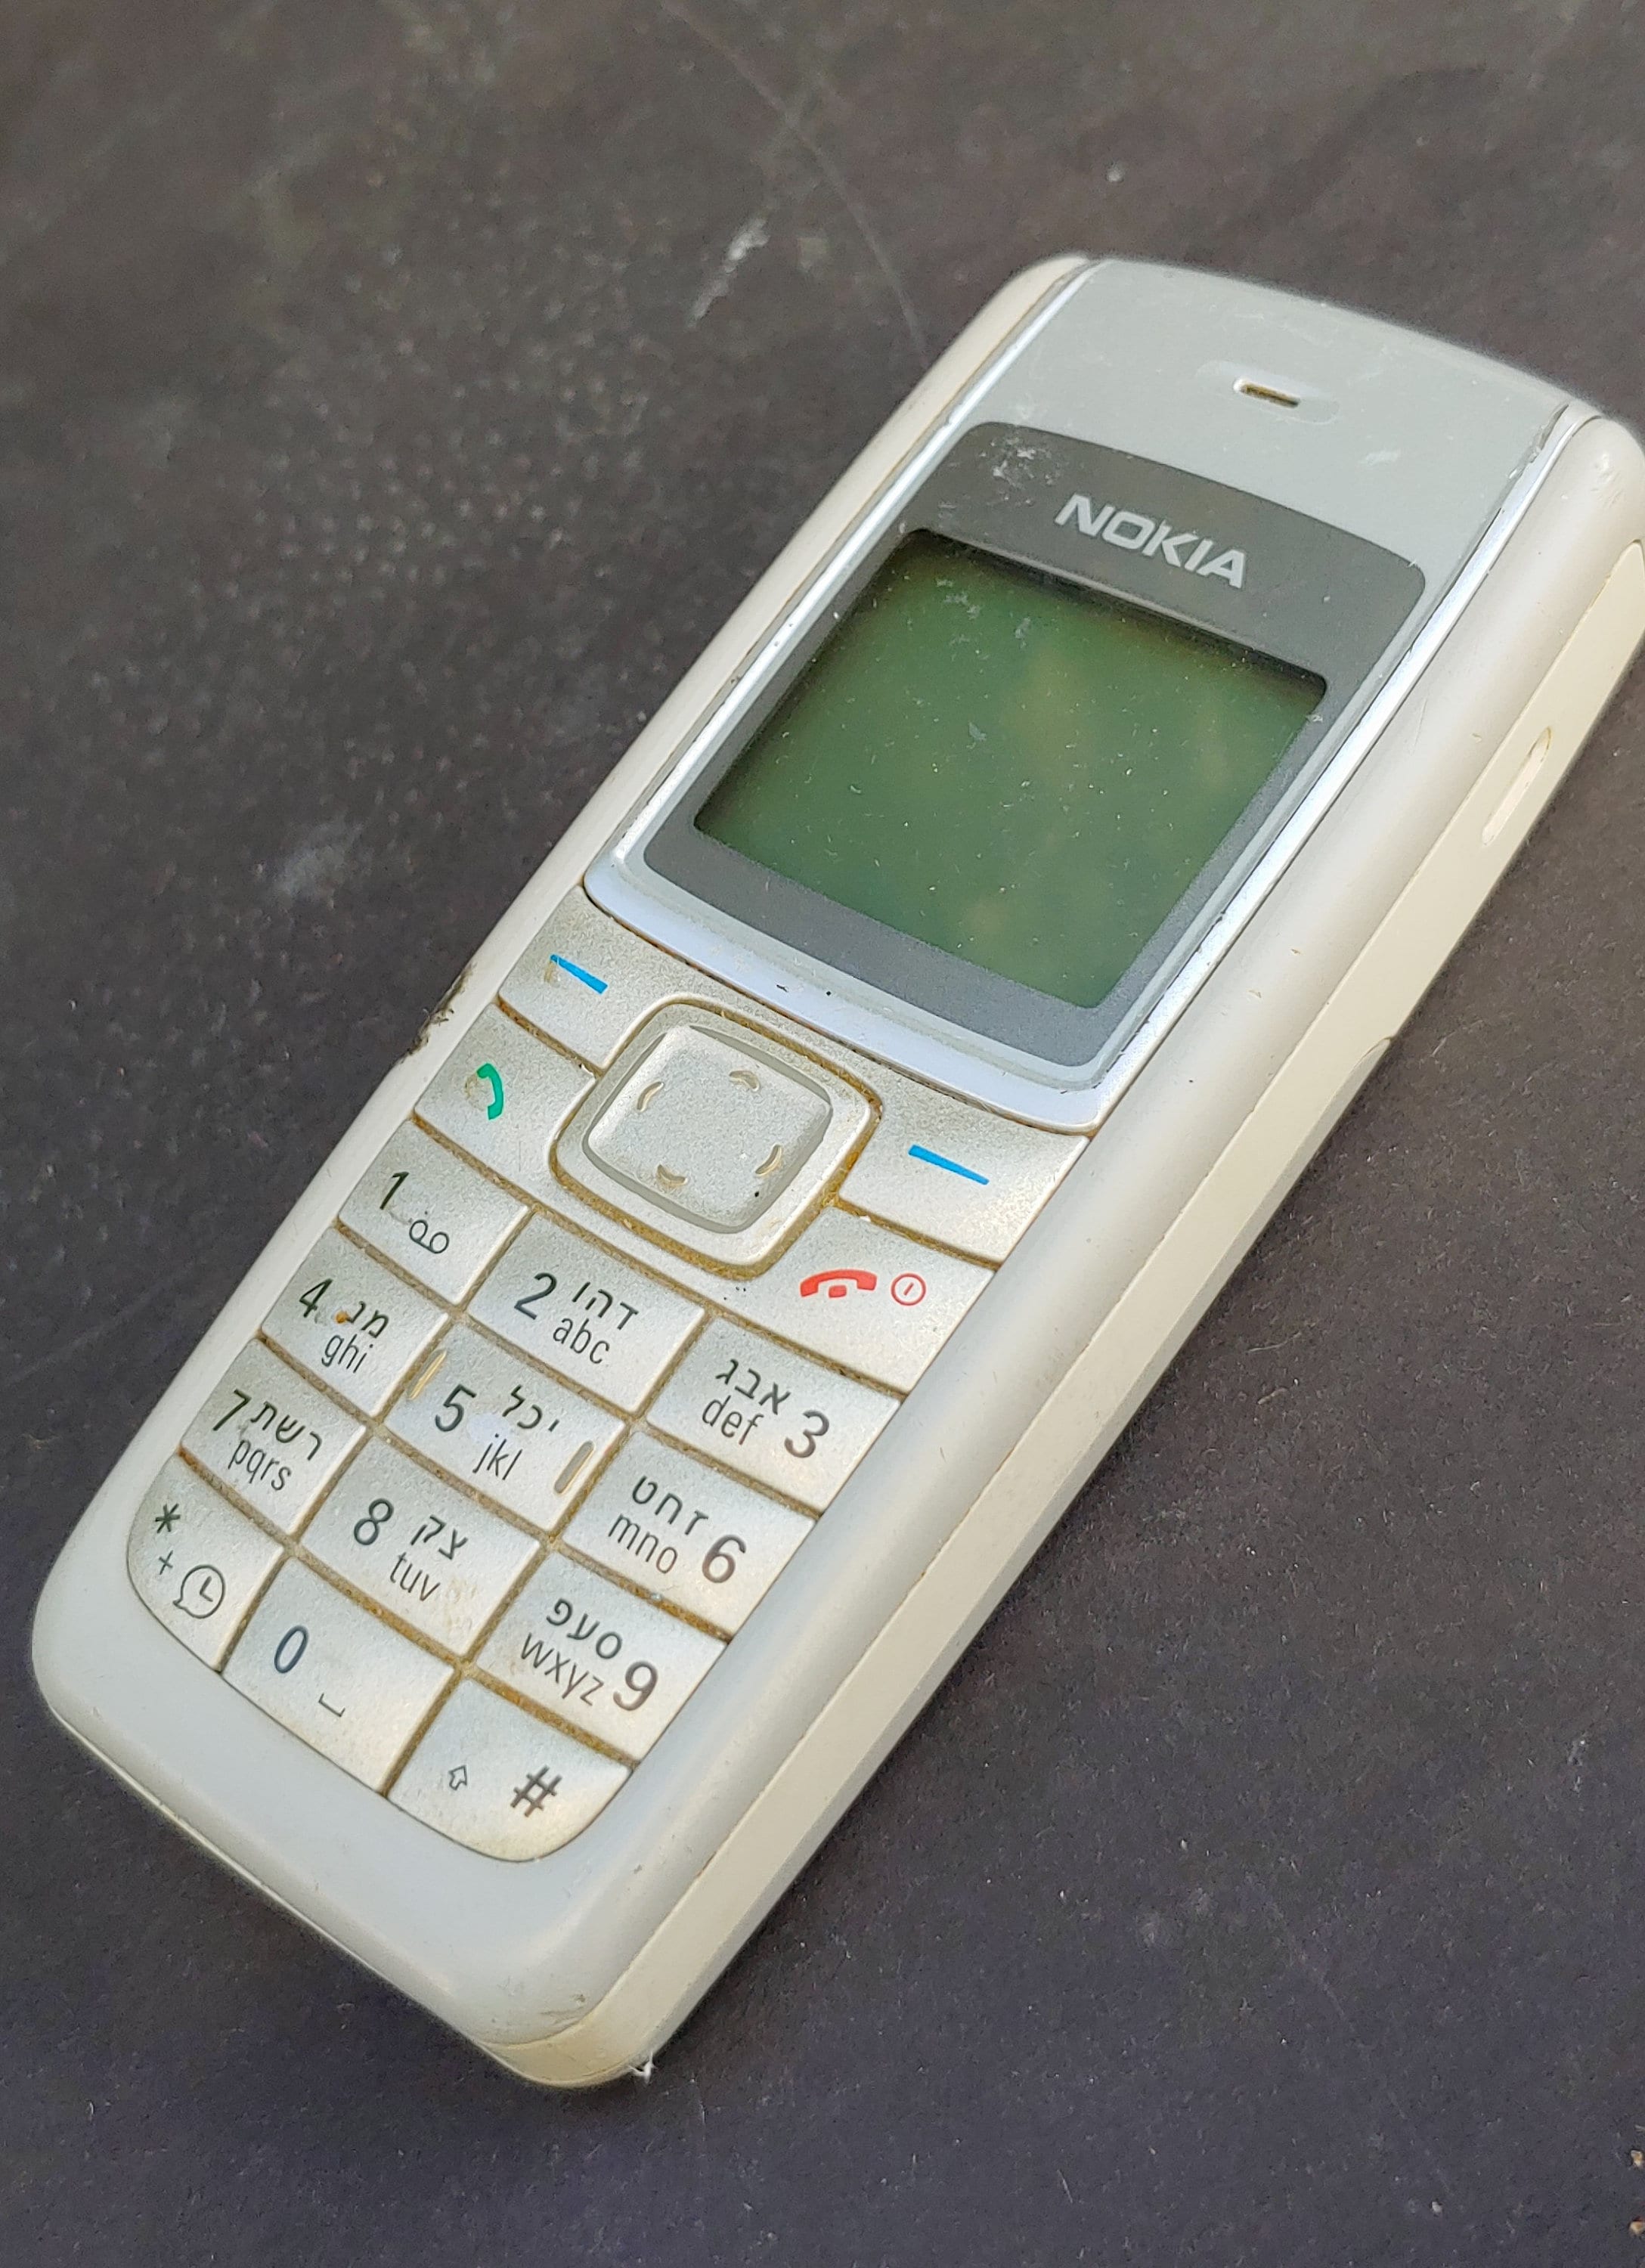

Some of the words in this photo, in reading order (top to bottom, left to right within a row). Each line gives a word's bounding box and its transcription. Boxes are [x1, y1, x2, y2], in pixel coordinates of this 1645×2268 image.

[1055, 493, 1247, 589] NOKIA
[379, 1171, 409, 1210] 1
[299, 1278, 333, 1318] 4
[514, 1272, 557, 1319] 2
[572, 1281, 639, 1331] דהו
[321, 1333, 374, 1374] ghi
[553, 1316, 611, 1365] abc
[212, 1389, 251, 1432] 7
[434, 1383, 477, 1432] 5
[501, 1385, 562, 1433] יכל
[714, 1359, 791, 1415] אבג
[250, 1401, 323, 1461] רשת
[702, 1395, 761, 1445] def
[783, 1410, 830, 1459] 3
[228, 1439, 292, 1491] pqrs
[472, 1433, 523, 1482] jkl
[353, 1498, 394, 1546] 8
[631, 1474, 708, 1538] זחט
[410, 1514, 469, 1560] צק
[608, 1513, 679, 1575] mno
[701, 1533, 747, 1583] 6
[389, 1552, 441, 1603] tuv
[273, 1625, 308, 1674] 0
[545, 1598, 622, 1660] סעפ
[520, 1633, 605, 1706] wxyz
[612, 1659, 659, 1712] 9
[510, 1766, 562, 1817] #
